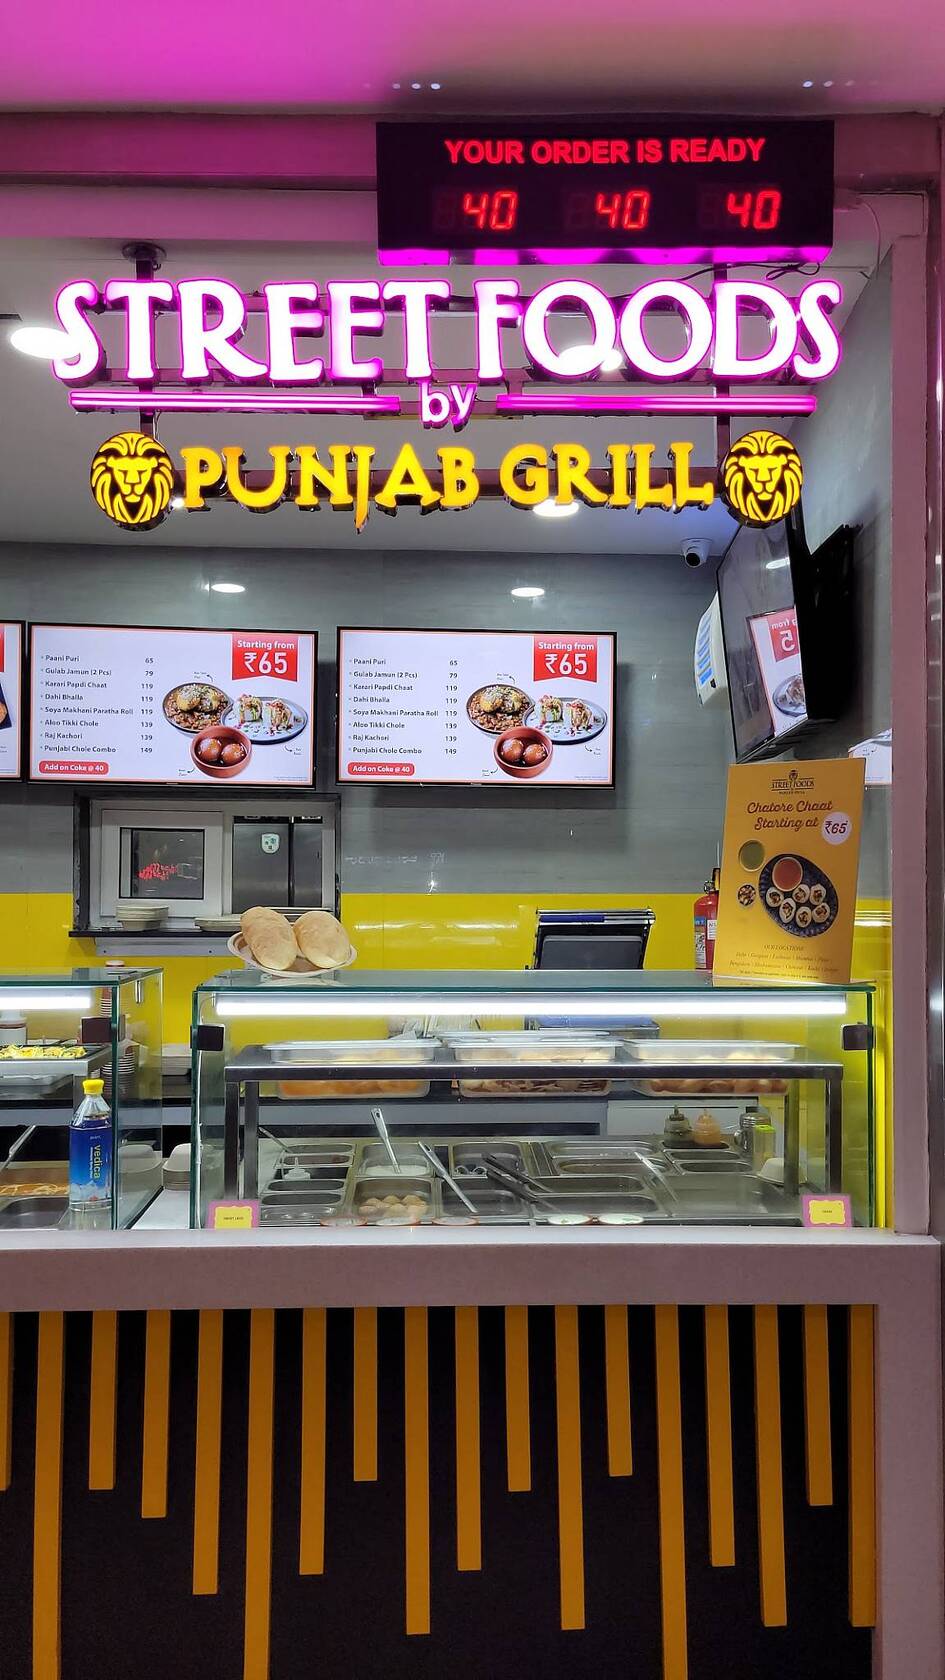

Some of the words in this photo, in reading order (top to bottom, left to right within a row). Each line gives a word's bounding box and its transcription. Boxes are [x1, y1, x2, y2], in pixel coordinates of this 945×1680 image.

[445, 140, 524, 164] YOUR
[531, 139, 630, 164] ORDER
[636, 139, 663, 163] IS
[670, 138, 766, 162] READY
[462, 190, 518, 230] 40
[595, 190, 651, 230] 40
[727, 190, 781, 230] 40
[52, 279, 450, 383] STREET
[473, 279, 843, 383] FOODS
[419, 381, 477, 428] by
[180, 443, 481, 531] PUNJAB
[499, 442, 715, 509] GRILL
[237, 640, 272, 650] Starting
[274, 641, 295, 649] from
[538, 641, 573, 651] Starting
[574, 642, 594, 650] from
[244, 652, 288, 674] ₹65
[545, 653, 587, 675] ₹65
[67, 681, 86, 689] Papdi
[45, 732, 55, 740] Raj
[44, 745, 70, 753] Punjabi
[747, 802, 793, 813] Chatore
[796, 800, 833, 812] Chaat
[754, 817, 803, 832] Starting
[805, 817, 819, 827] at
[824, 820, 848, 834] ₹65
[94, 1145, 103, 1179] vedica
